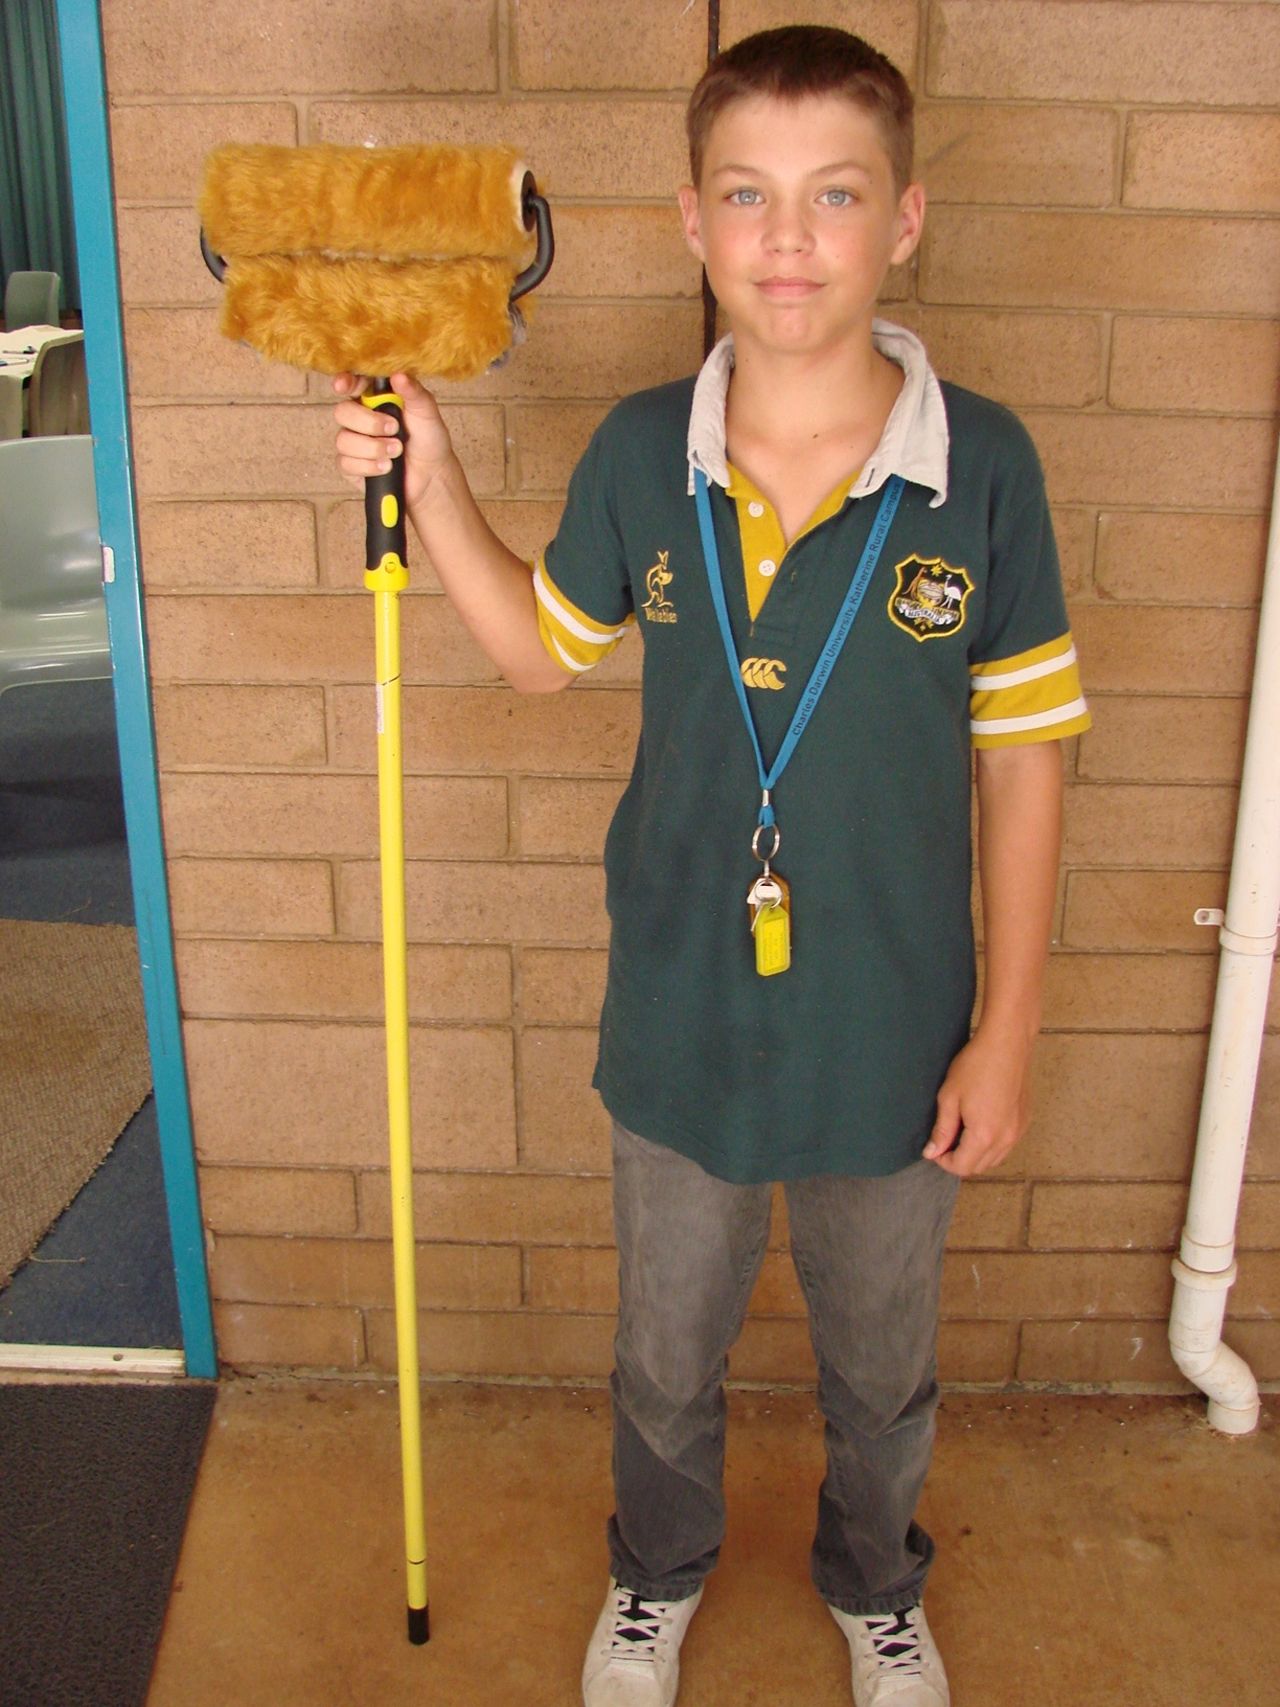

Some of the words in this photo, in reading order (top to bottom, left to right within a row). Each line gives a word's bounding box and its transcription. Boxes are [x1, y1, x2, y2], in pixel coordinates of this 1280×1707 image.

[792, 698, 816, 736] Charles
[808, 659, 832, 696] Darwin
[825, 606, 857, 658] University
[849, 553, 876, 605] Katherine
[869, 525, 887, 553] Rural
